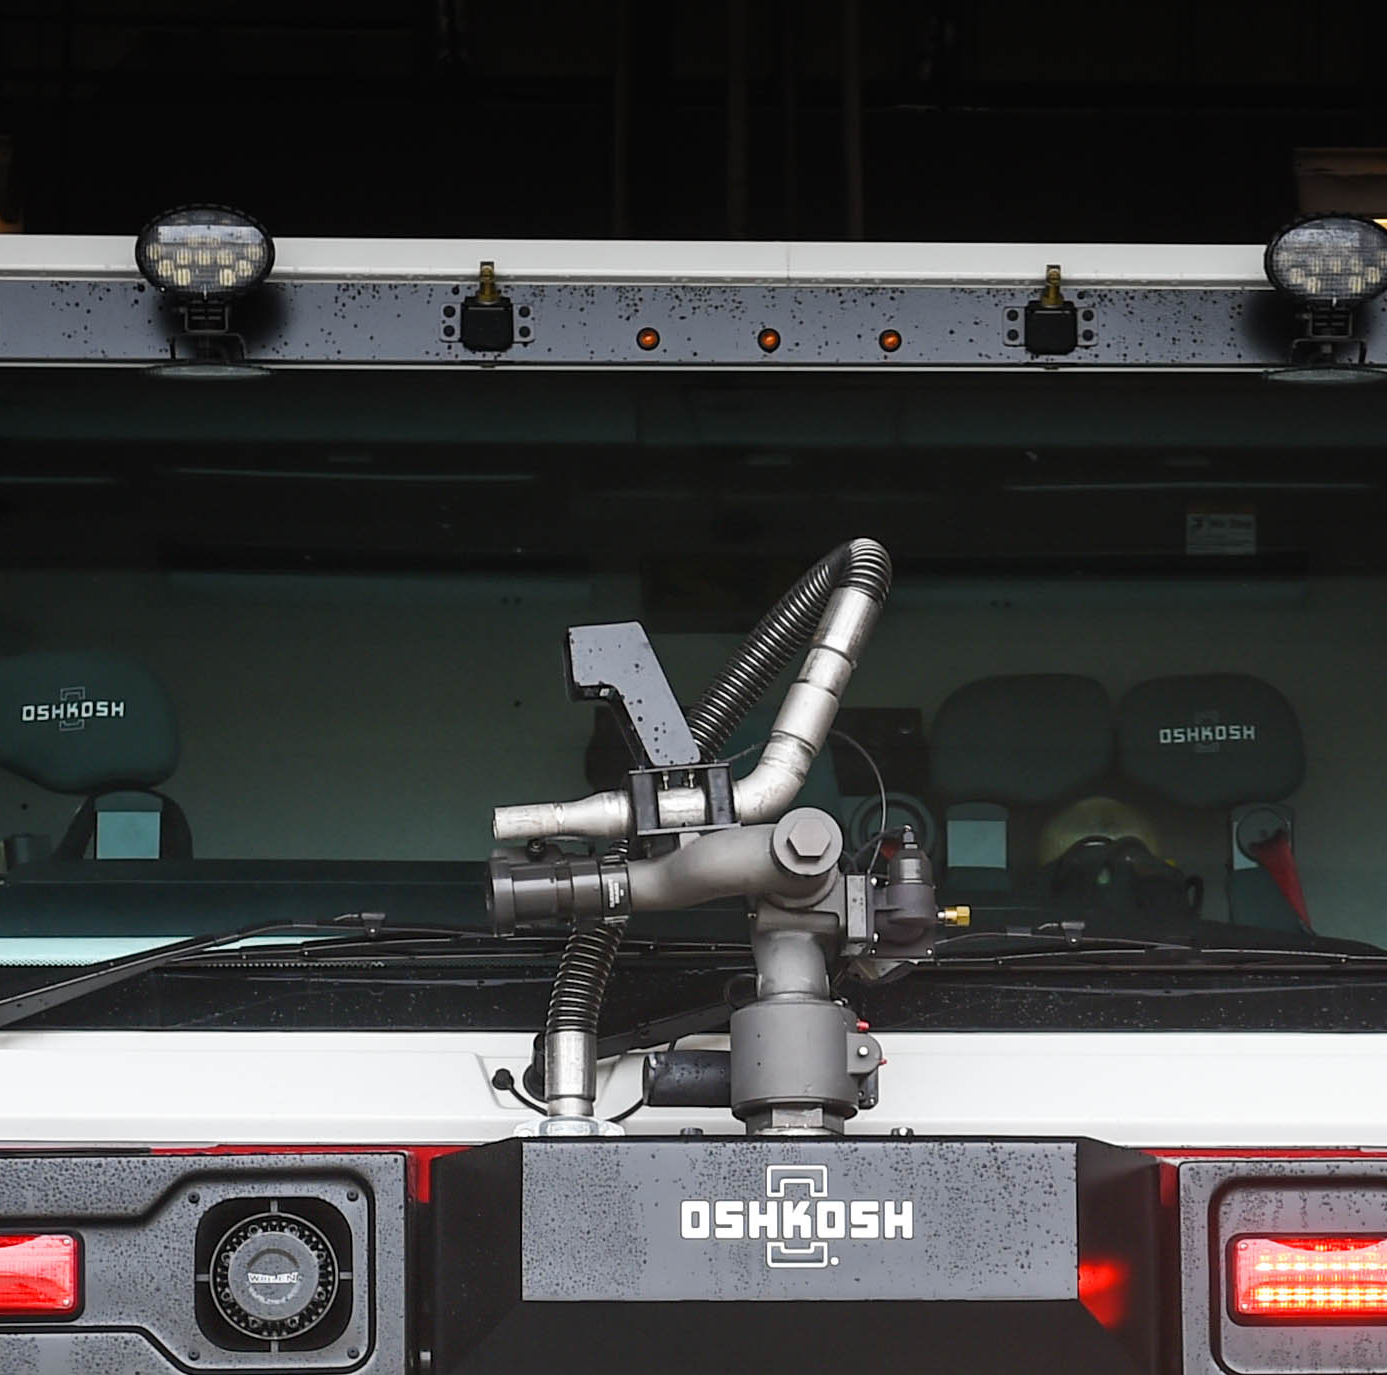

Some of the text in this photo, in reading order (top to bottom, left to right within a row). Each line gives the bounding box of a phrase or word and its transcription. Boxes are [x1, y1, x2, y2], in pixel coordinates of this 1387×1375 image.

[22, 701, 125, 722] OSHKOSH
[1159, 724, 1255, 744] OSHKOSH
[680, 1200, 914, 1239] OSHKOSH
